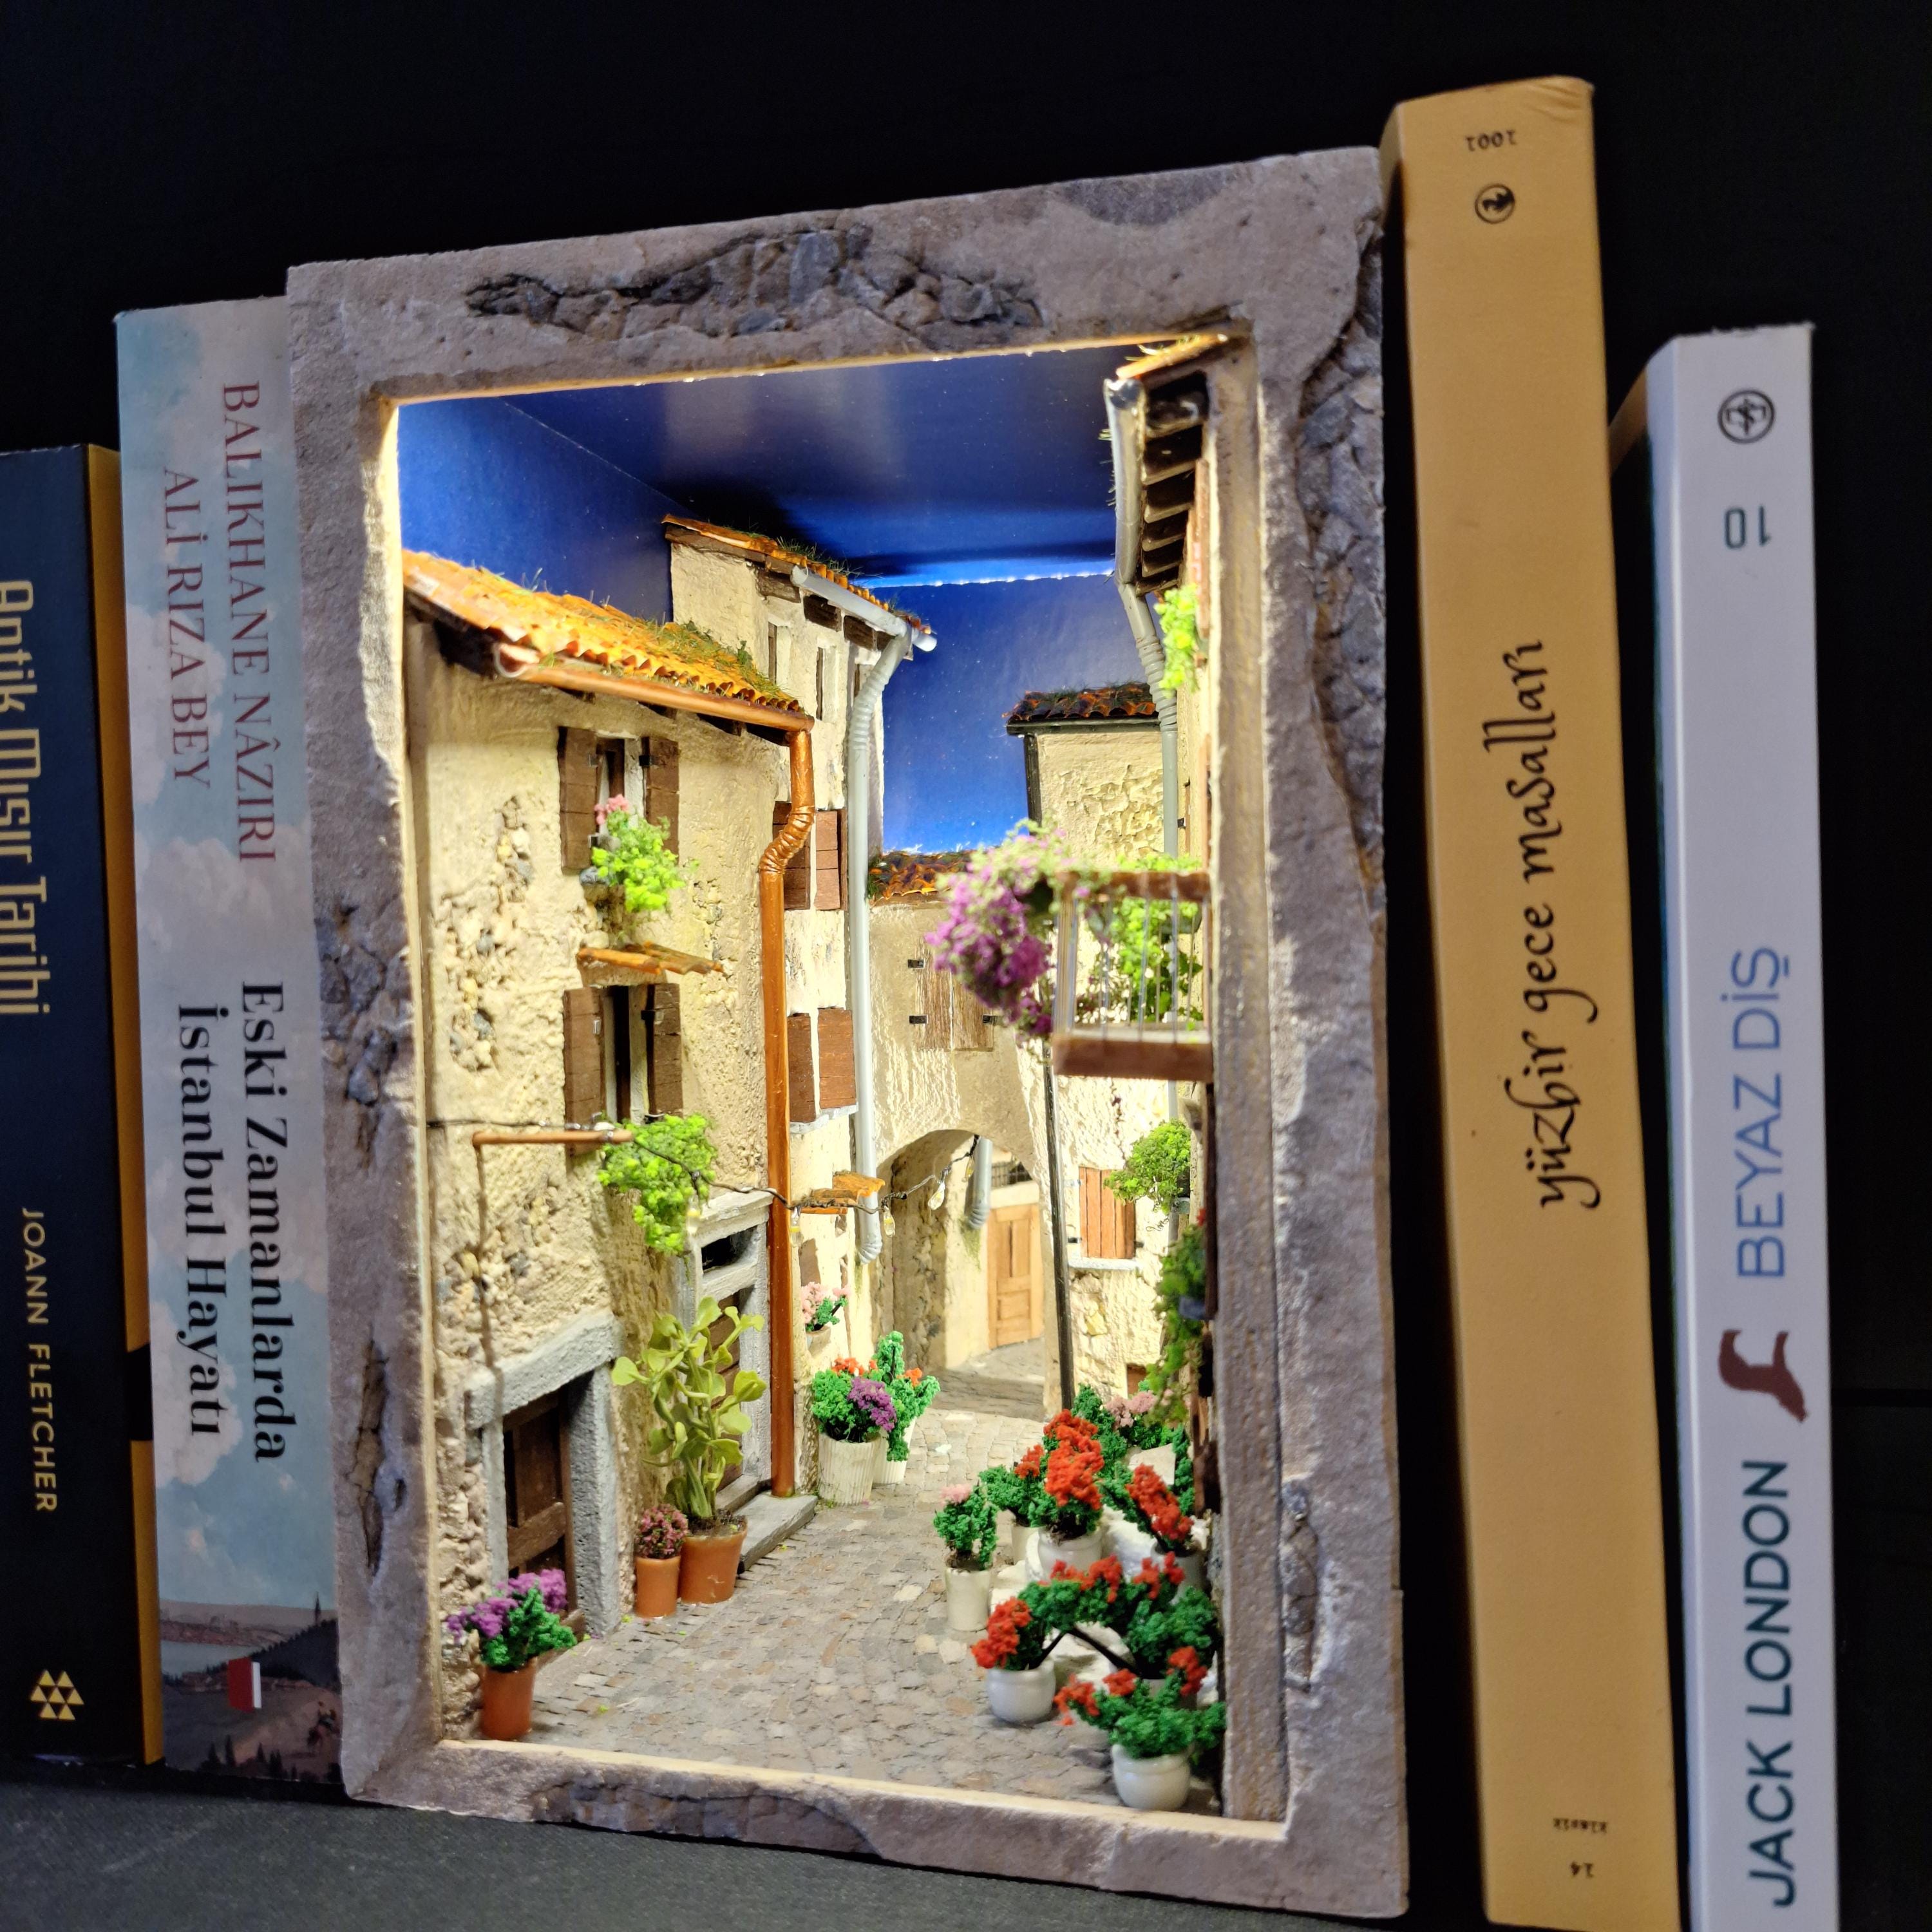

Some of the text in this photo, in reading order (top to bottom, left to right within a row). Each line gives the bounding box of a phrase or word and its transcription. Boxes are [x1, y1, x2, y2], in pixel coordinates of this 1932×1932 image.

[1464, 129, 1517, 152] 1001
[164, 466, 211, 789] ALİ RIZA BEY
[223, 381, 281, 862] BALIKHANE NÂZIRI
[1724, 506, 1771, 549] 10
[1482, 639, 1562, 884] masalları
[0, 876, 50, 1014] Tarihi
[1523, 903, 1598, 1023] gece
[176, 1003, 229, 1436] İstanbul Hayatı
[242, 981, 296, 1463] Eski Zamanlarda
[1719, 947, 1789, 1277] BEYAZ DİŞ
[22, 1208, 57, 1512] JOANN FLETCHER
[1741, 1461, 1795, 1907] JACK LONDON
